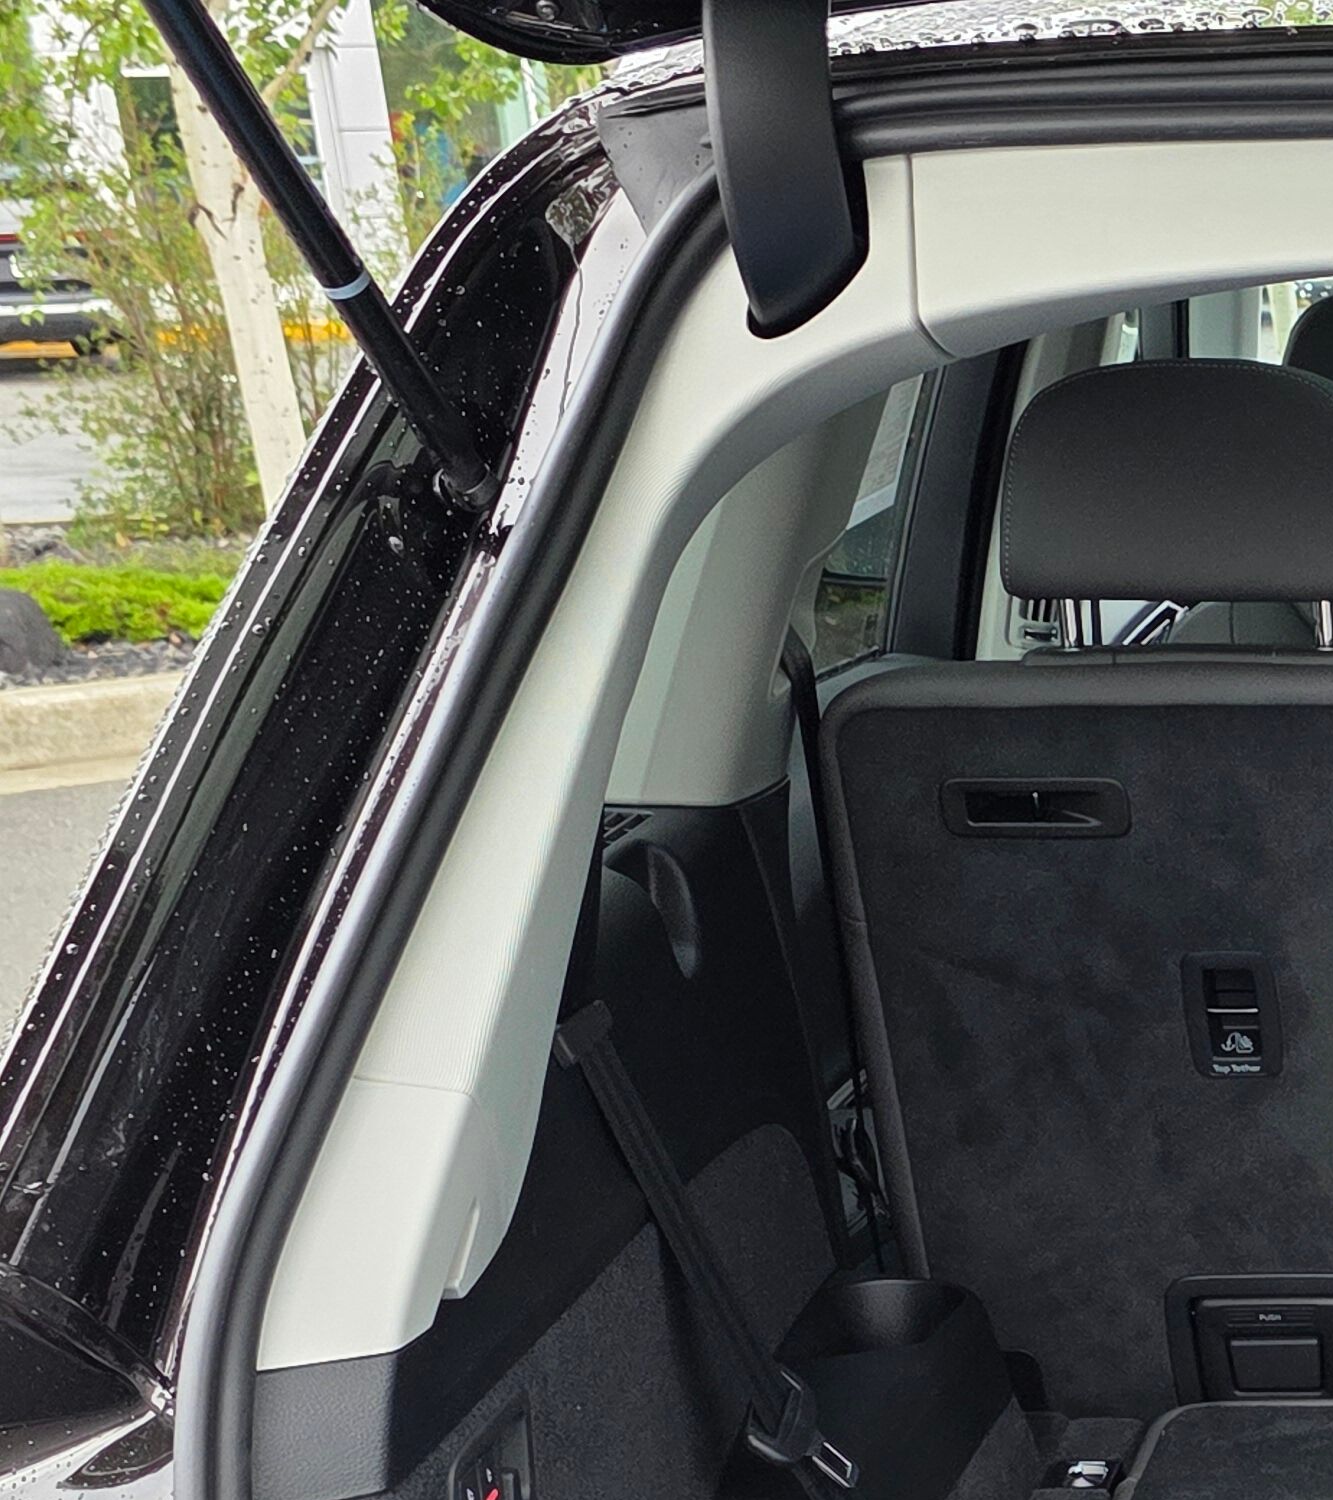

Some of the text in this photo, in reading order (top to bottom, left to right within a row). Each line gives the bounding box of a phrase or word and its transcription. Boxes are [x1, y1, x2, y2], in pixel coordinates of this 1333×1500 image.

[1212, 1064, 1261, 1074] Top Tether
[1258, 1313, 1282, 1321] PUSH
